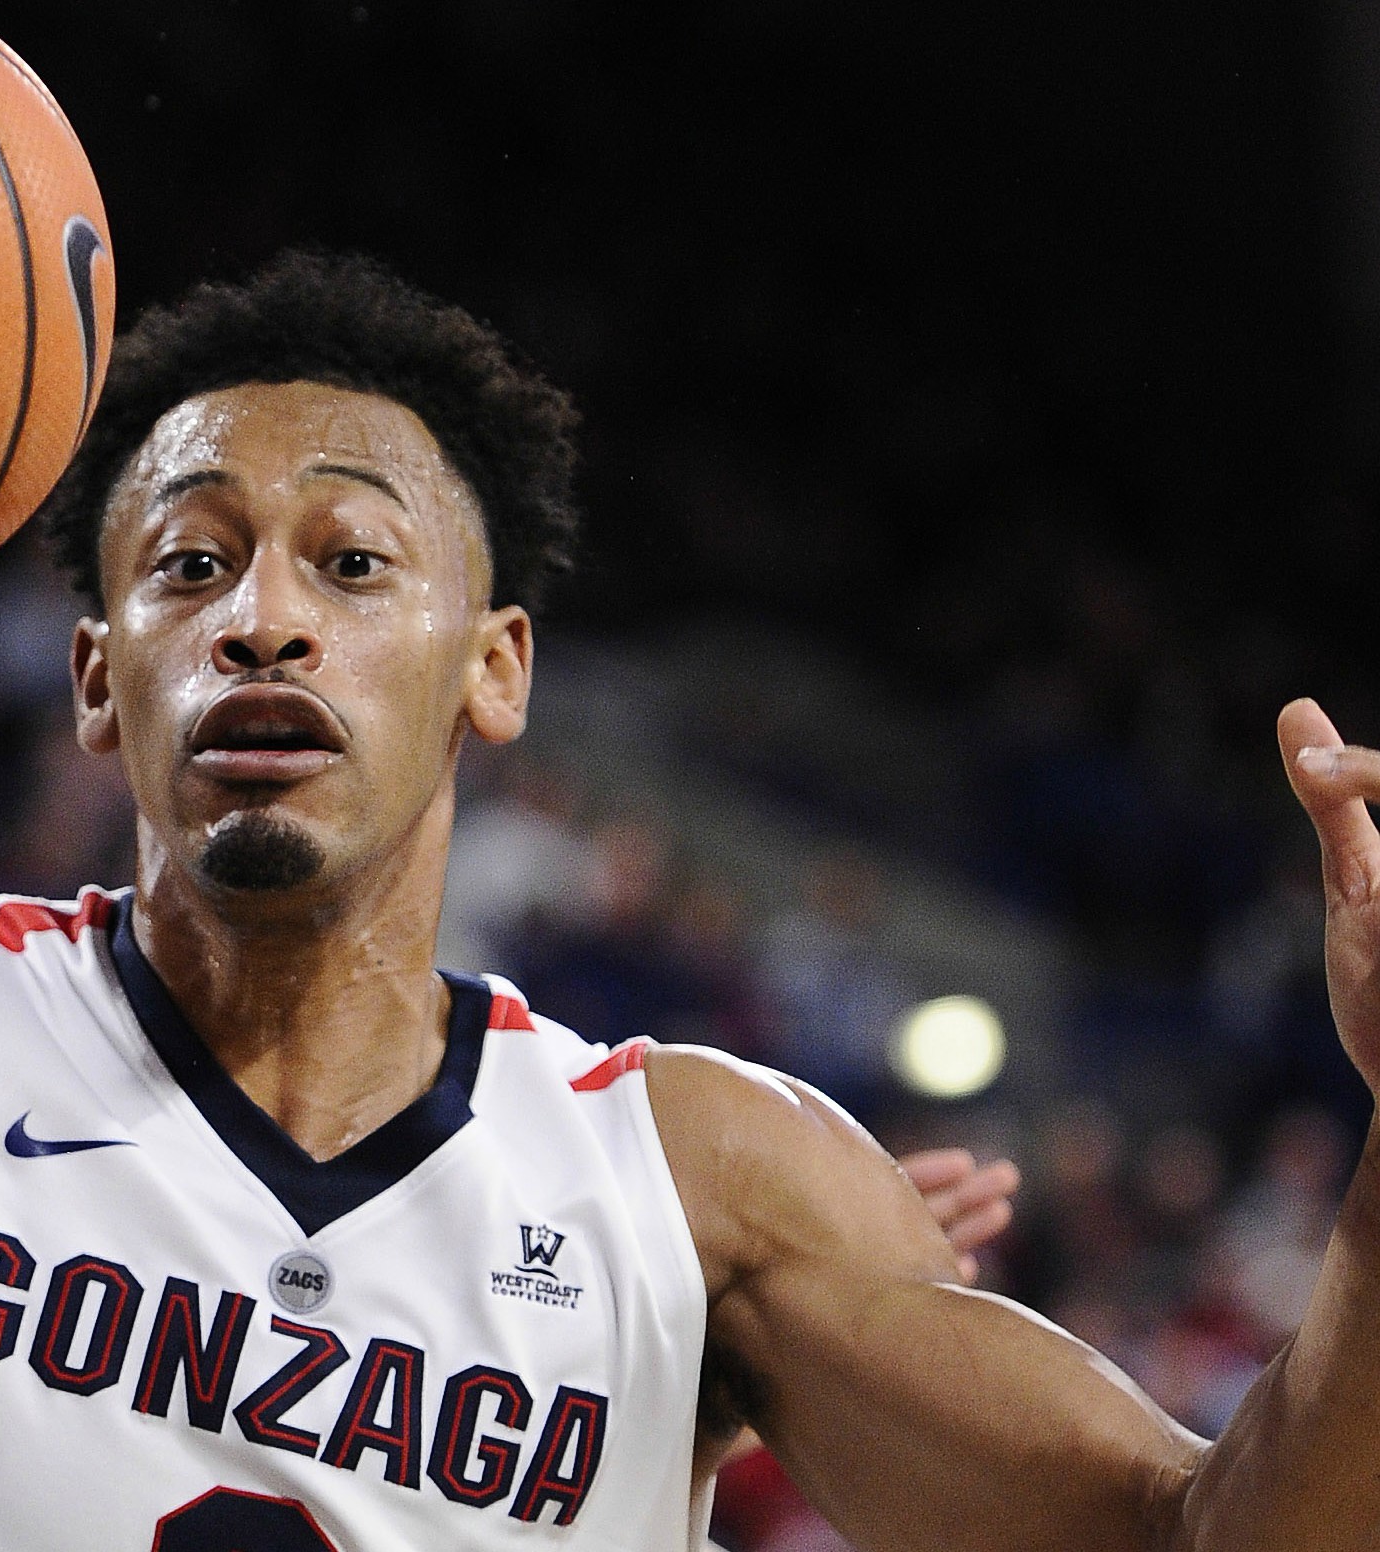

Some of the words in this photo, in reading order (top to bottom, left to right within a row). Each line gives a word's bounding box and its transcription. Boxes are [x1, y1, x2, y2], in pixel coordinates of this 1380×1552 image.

[278, 1266, 324, 1292] ZAGS
[491, 1271, 534, 1289] WEST
[535, 1280, 583, 1299] COAST
